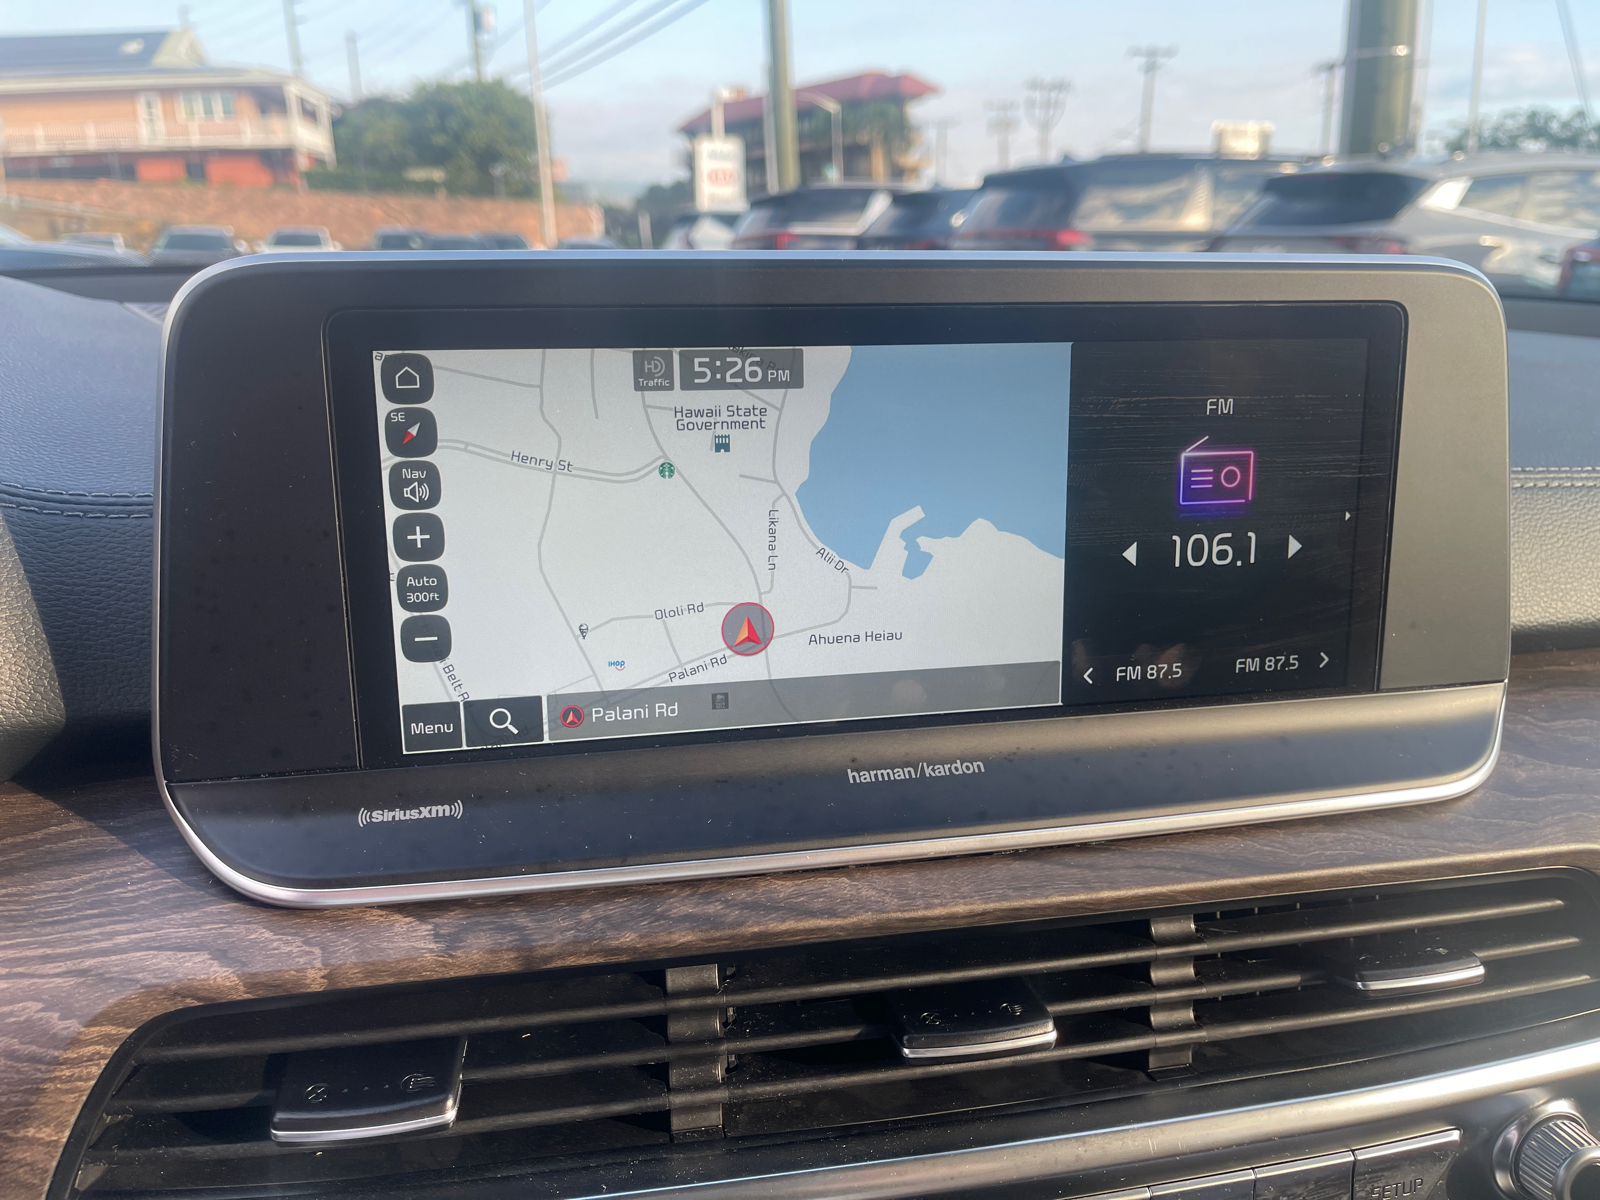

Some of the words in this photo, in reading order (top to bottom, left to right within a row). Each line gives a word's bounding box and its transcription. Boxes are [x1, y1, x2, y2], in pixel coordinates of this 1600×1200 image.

[693, 357, 763, 383] 5:26
[768, 369, 790, 382] PM
[638, 378, 670, 387] Traffic
[674, 405, 722, 419] Hawaii
[726, 404, 768, 418] State
[1206, 398, 1234, 415] FM
[390, 412, 405, 422] SE
[676, 417, 766, 431] Government
[510, 450, 555, 471] Henry
[557, 459, 574, 473] St
[402, 468, 427, 479] Nav
[768, 509, 779, 551] Likana
[1172, 531, 1256, 568] 106.1
[767, 554, 779, 571] Ln
[815, 547, 836, 565] Alii
[830, 559, 850, 575] Dr
[406, 576, 437, 587] Auto
[406, 592, 440, 603] 300ft
[654, 606, 684, 621] Ololi
[687, 602, 705, 615] Rd
[808, 631, 860, 646] Ahuena
[864, 630, 903, 643] Heiau
[668, 661, 708, 683] Palani
[709, 654, 728, 669] Rd
[1116, 666, 1141, 682] FM
[1146, 663, 1182, 680] 87.5
[1236, 658, 1260, 674] FM
[1264, 655, 1299, 672] 87.5
[443, 664, 463, 692] Belt
[591, 704, 650, 722] Palani
[655, 702, 679, 718] Rd
[410, 721, 454, 735] Menu
[846, 759, 985, 784] harman/kardon
[1370, 1177, 1424, 1200] SETUP
